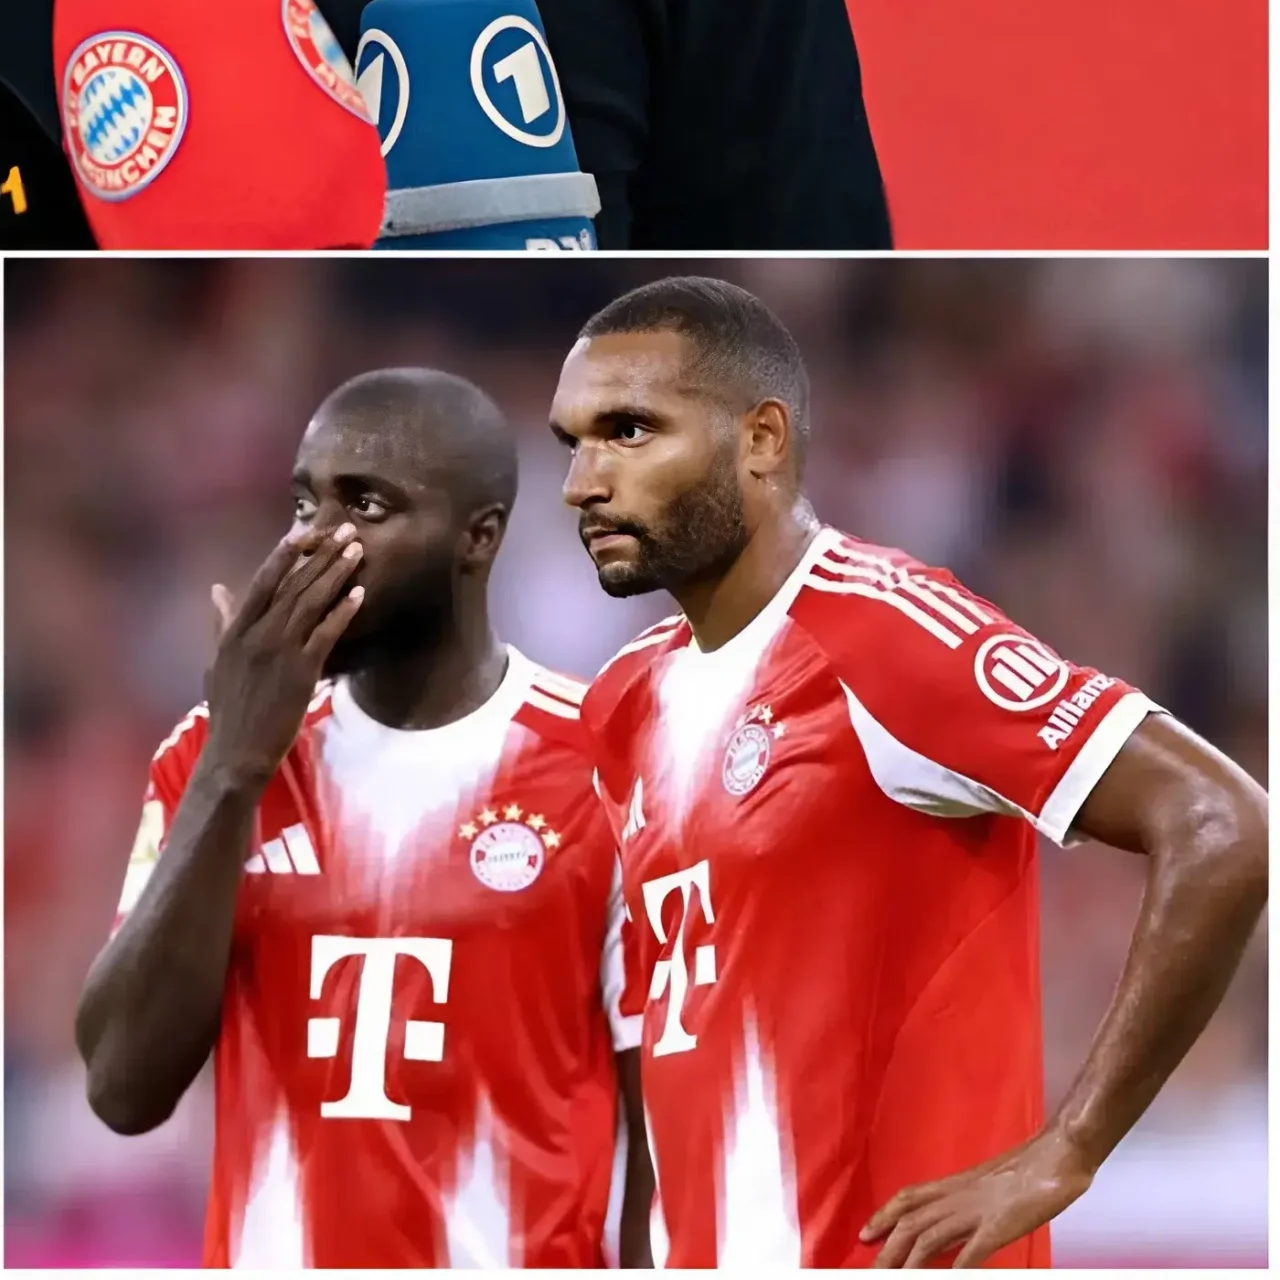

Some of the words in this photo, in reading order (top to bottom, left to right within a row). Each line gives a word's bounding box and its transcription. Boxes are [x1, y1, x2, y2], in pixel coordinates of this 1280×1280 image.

[73, 42, 166, 87] BAYERN
[492, 41, 551, 125] 1
[1036, 673, 1117, 751] Allianz
[307, 934, 453, 1121] T
